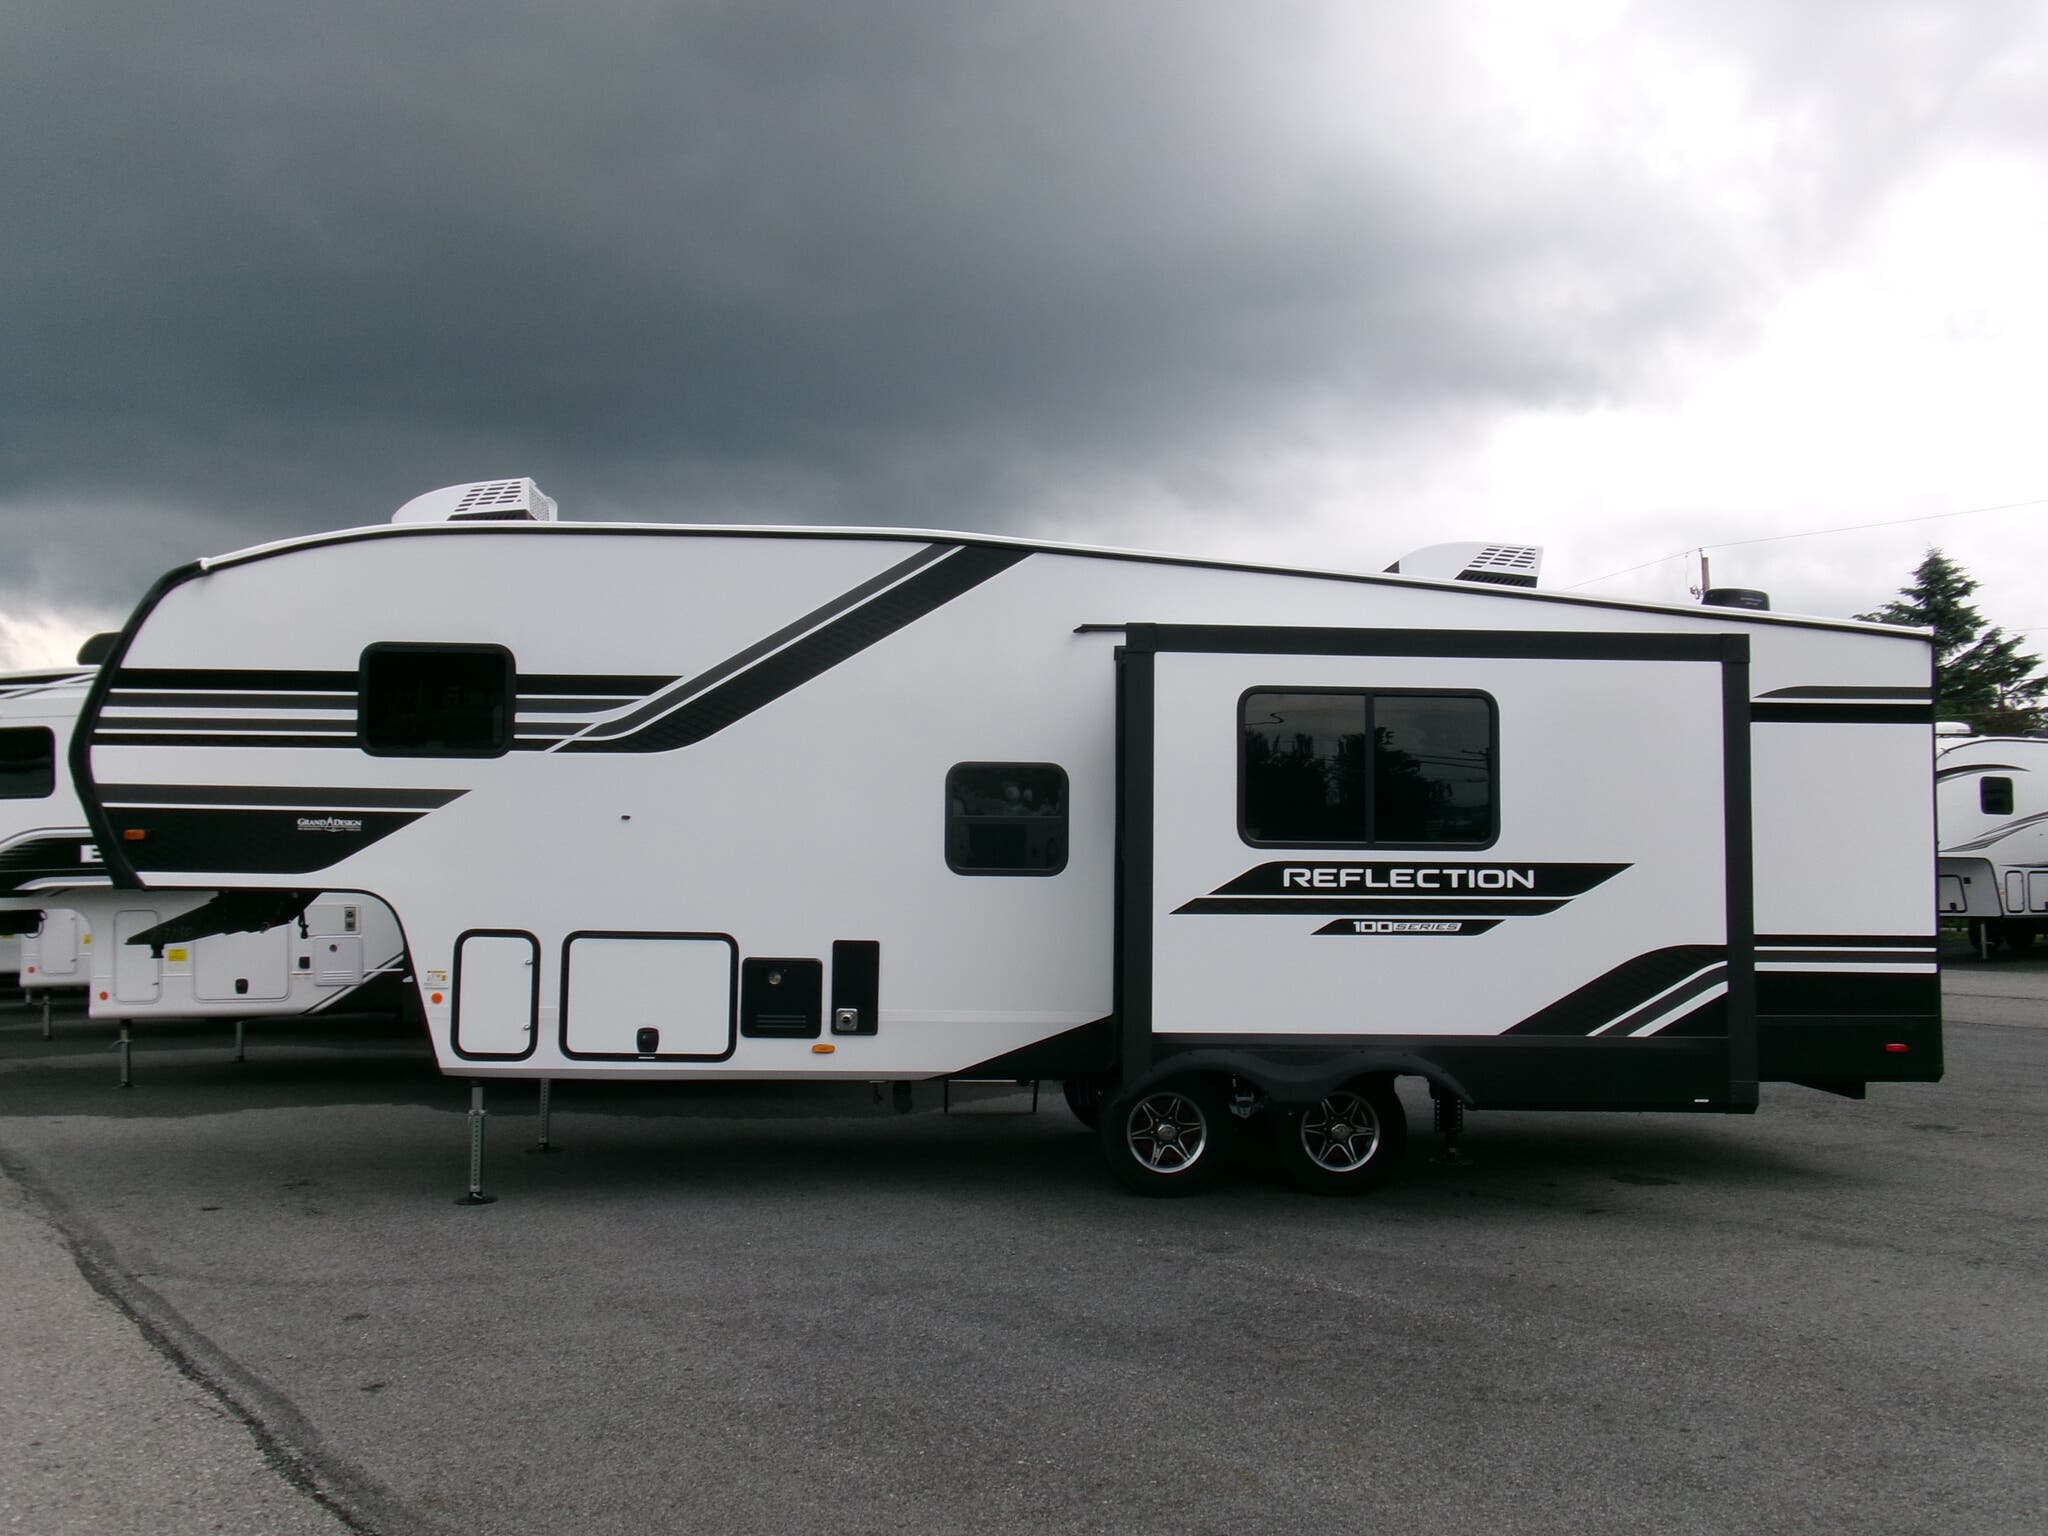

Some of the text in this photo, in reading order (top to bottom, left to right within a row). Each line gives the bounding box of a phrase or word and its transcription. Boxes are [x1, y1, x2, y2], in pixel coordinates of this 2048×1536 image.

[297, 818, 326, 826] GRAND
[1283, 868, 1535, 889] REFLECTION
[1353, 921, 1457, 932] 100 SERIES
